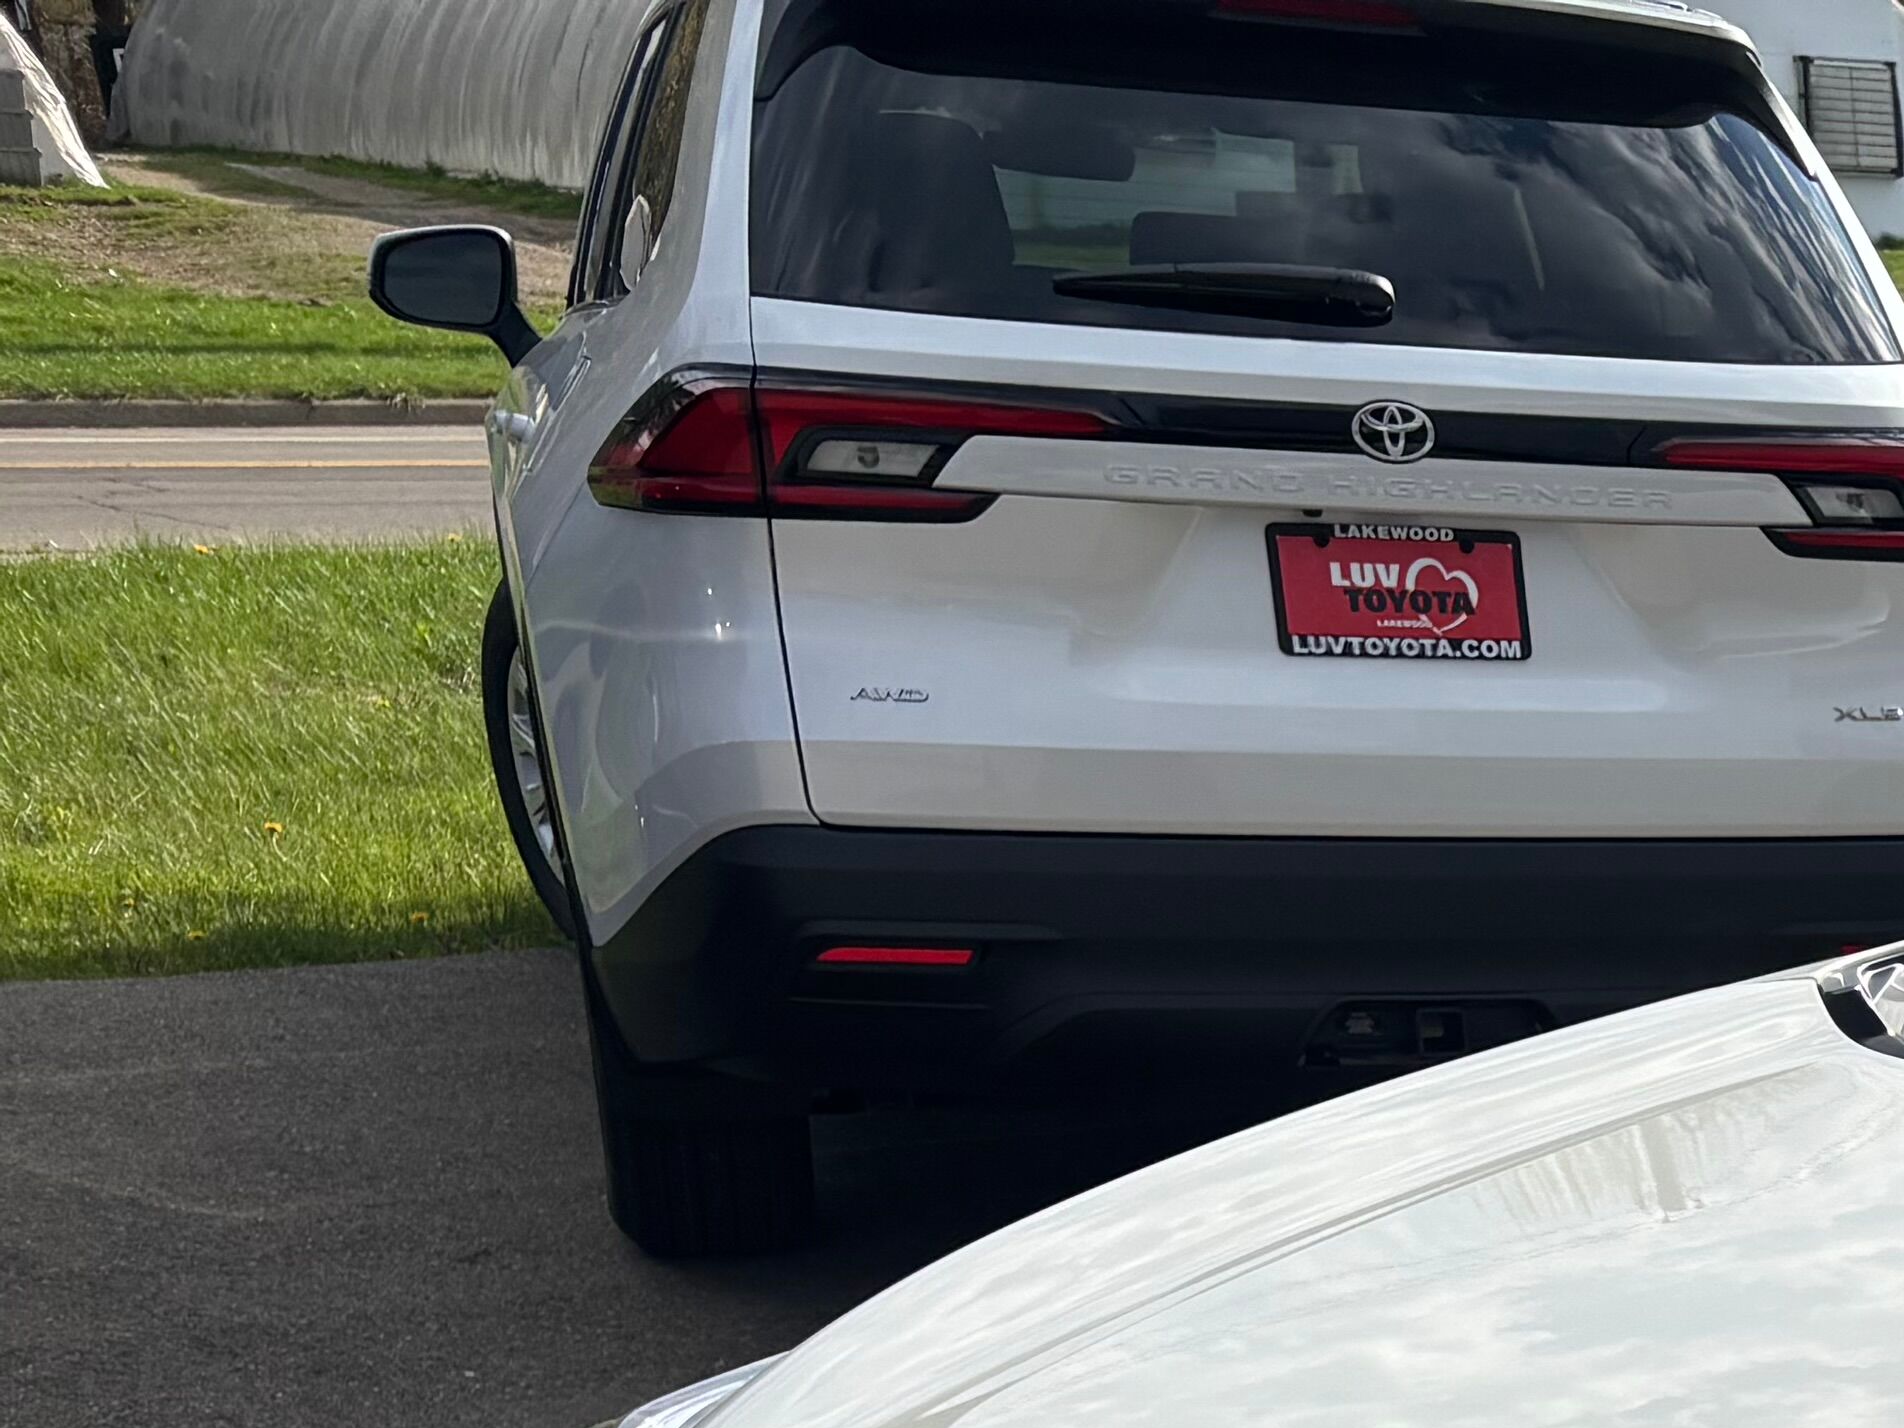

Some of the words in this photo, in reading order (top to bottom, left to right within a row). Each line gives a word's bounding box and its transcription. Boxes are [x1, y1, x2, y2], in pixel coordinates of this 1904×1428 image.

[1103, 462, 1301, 495] GRAND
[1327, 473, 1673, 511] HIGHLANDER
[1333, 523, 1455, 543] LAKEWOOD
[1329, 561, 1400, 588] LUV
[1343, 587, 1477, 616] TOYOTA
[1376, 619, 1434, 629] LAKEWOOD
[1291, 634, 1523, 660] LUVTOYOTA.COM
[850, 687, 930, 704] AWD
[1832, 705, 1904, 723] XLE
